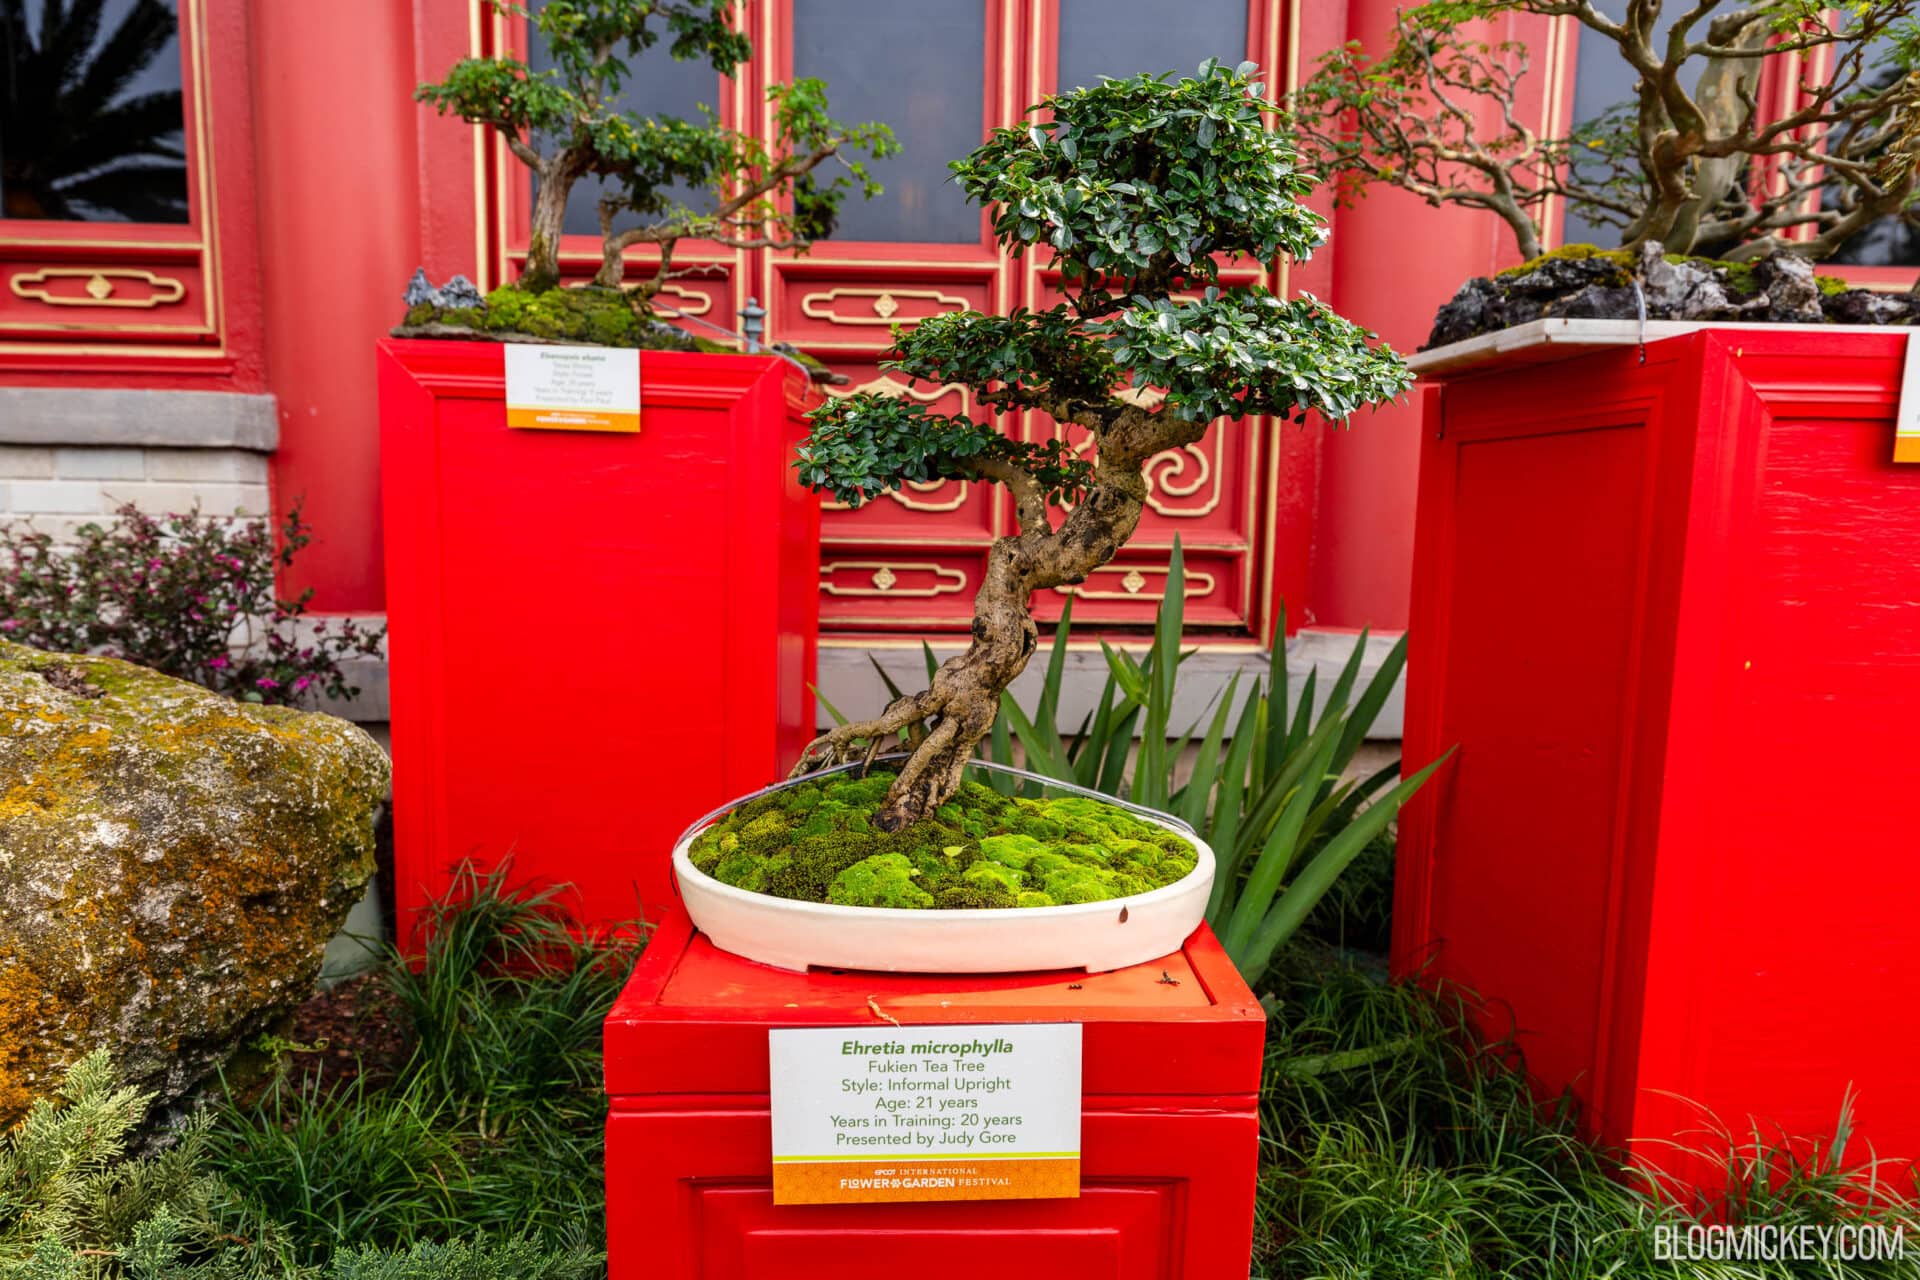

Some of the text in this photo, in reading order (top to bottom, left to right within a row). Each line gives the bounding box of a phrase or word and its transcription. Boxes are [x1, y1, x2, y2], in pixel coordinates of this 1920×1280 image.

[841, 1038, 1013, 1057] Ehretia microphylla
[868, 1059, 985, 1073] Fukien Tea Tree
[841, 1077, 1012, 1095] Style: Informal Upright
[874, 1096, 978, 1113] Age: 21 years
[829, 1113, 1023, 1131] Years in Training: 20 years
[836, 1131, 1017, 1148] Presented by Judy Gore
[840, 1177, 1011, 1189] FLOWER GARDEN FESTIVAL
